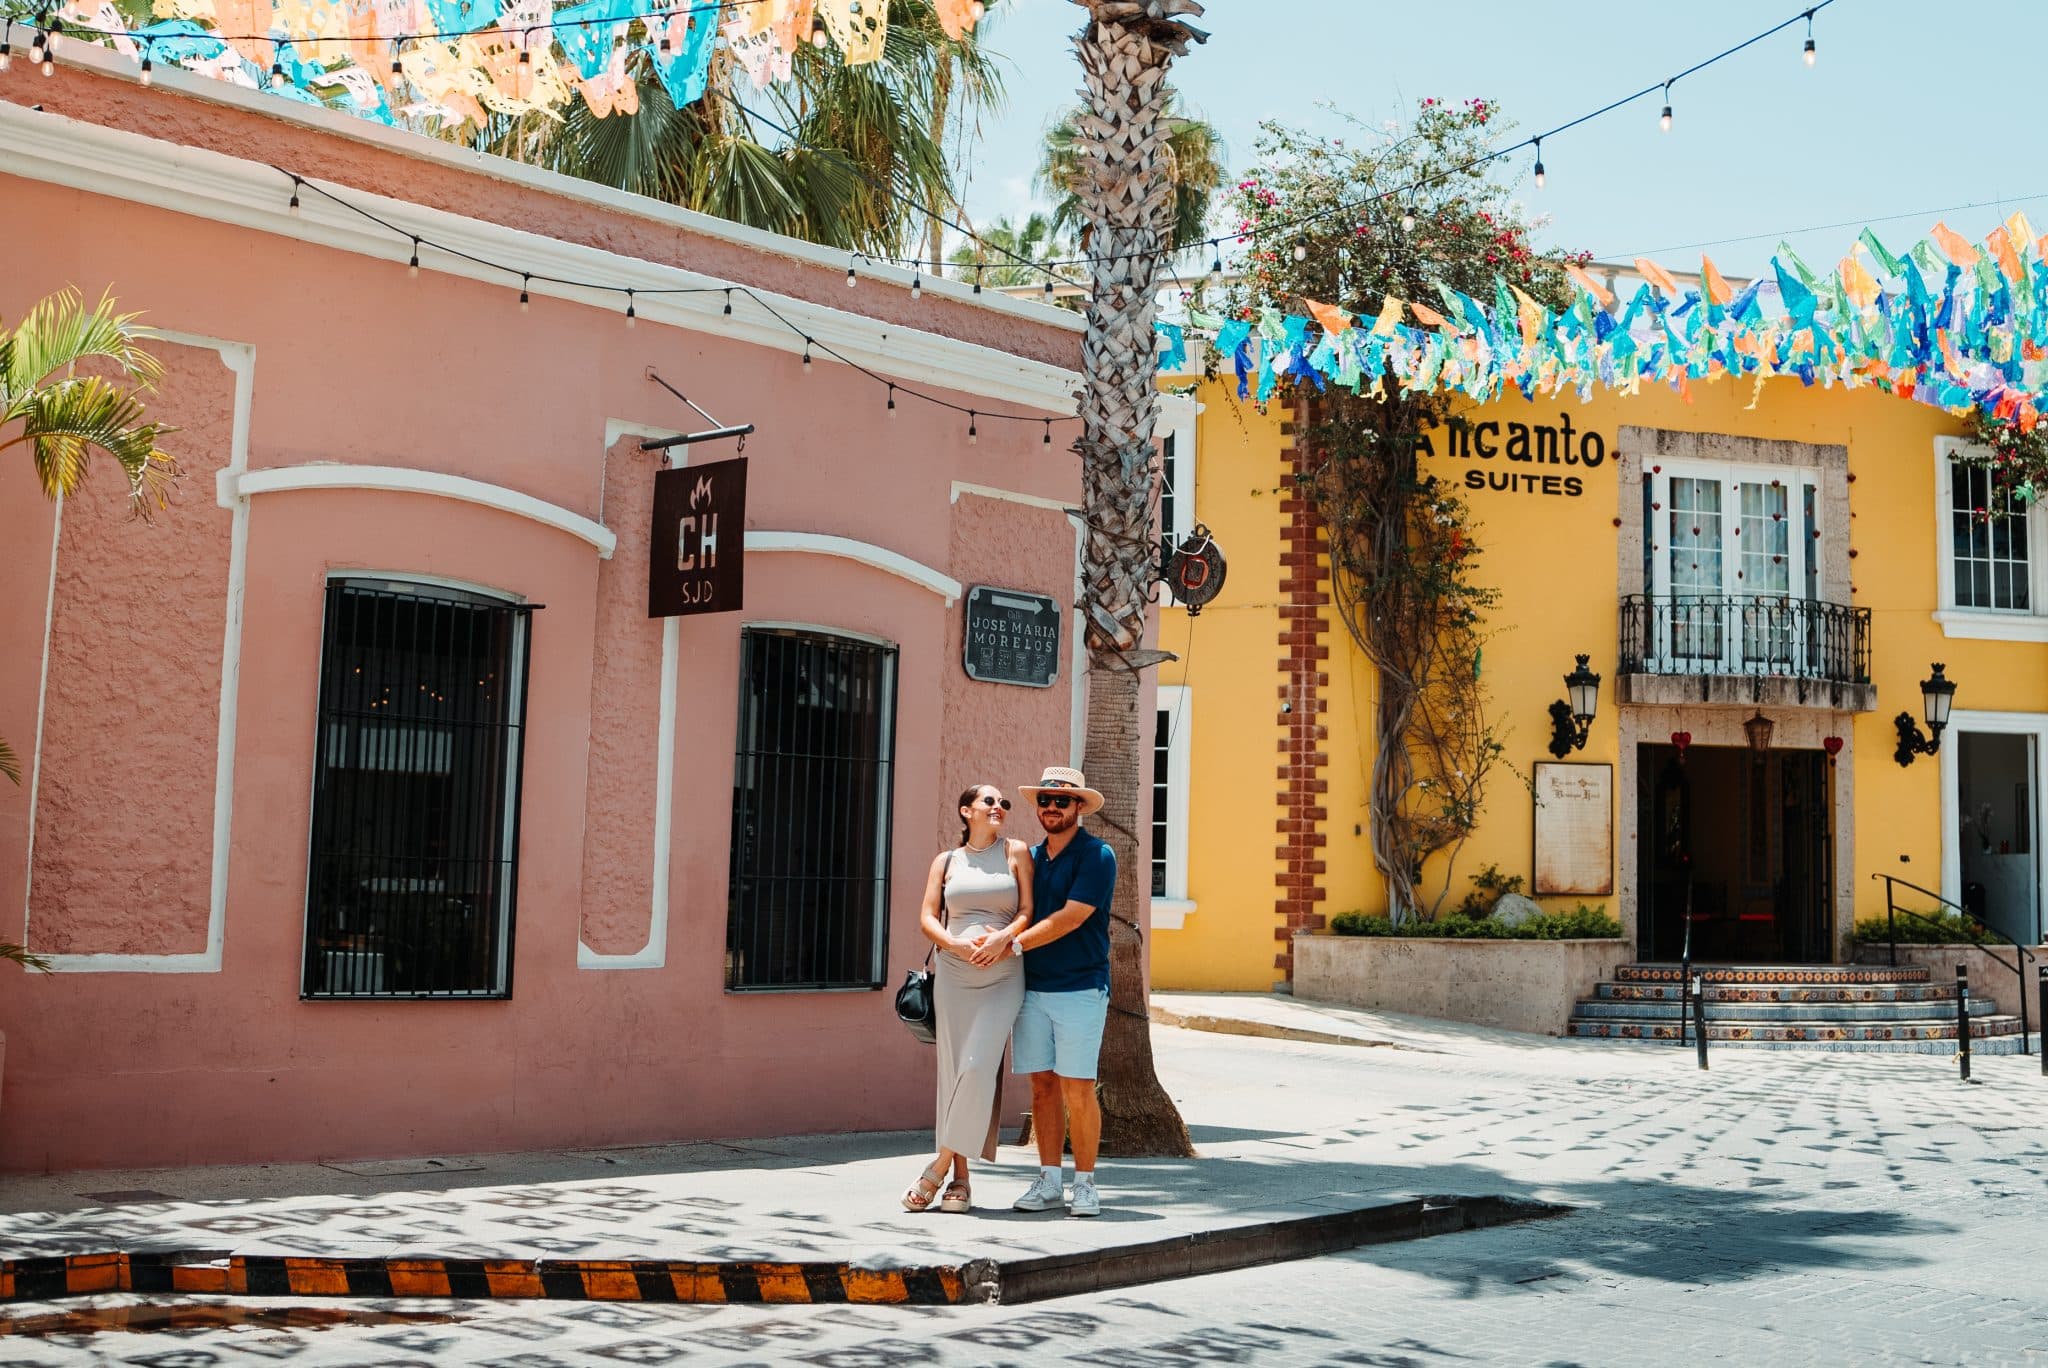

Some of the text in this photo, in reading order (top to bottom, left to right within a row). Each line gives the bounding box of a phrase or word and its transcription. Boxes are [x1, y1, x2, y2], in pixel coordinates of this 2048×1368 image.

[1464, 469, 1583, 497] SUITES
[677, 513, 718, 571] CH
[682, 580, 713, 604] SJD
[972, 616, 1056, 639] JOSE MARIA
[974, 632, 1053, 653] MORELOS
